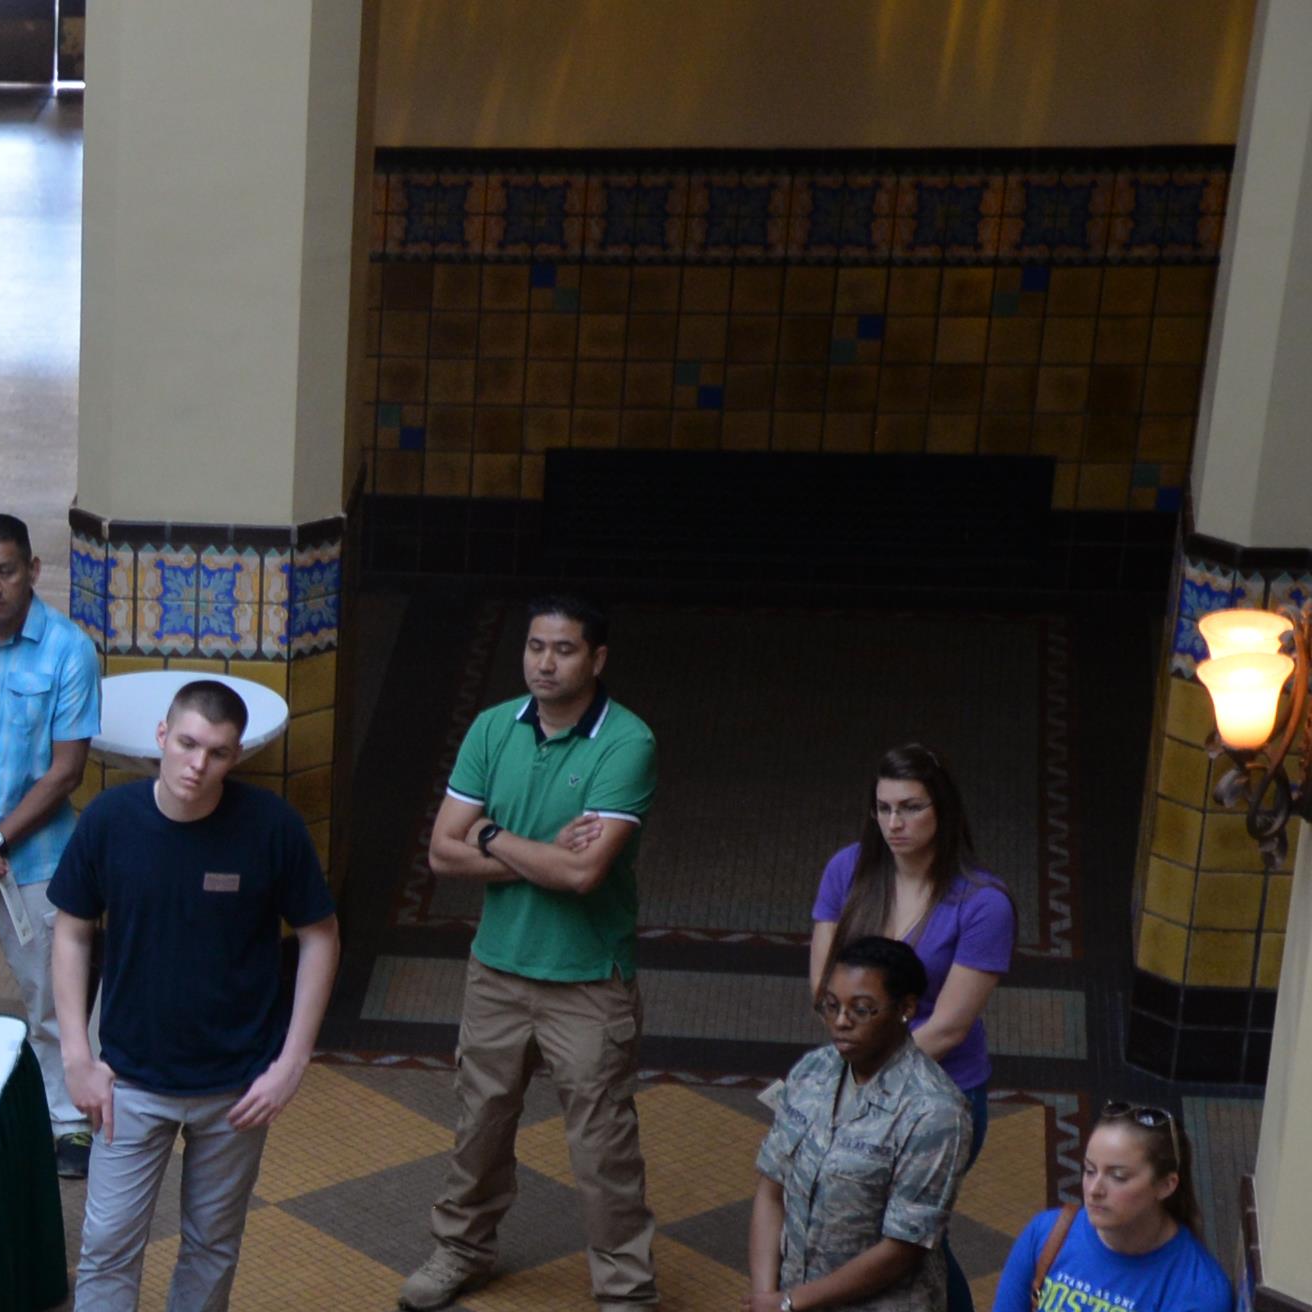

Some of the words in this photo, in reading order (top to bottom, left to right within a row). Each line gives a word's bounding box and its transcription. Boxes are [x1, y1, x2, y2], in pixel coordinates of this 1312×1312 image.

[1057, 1271, 1093, 1293] STAND
[1095, 1288, 1110, 1300] AS
[1114, 1296, 1136, 1310] ONE
